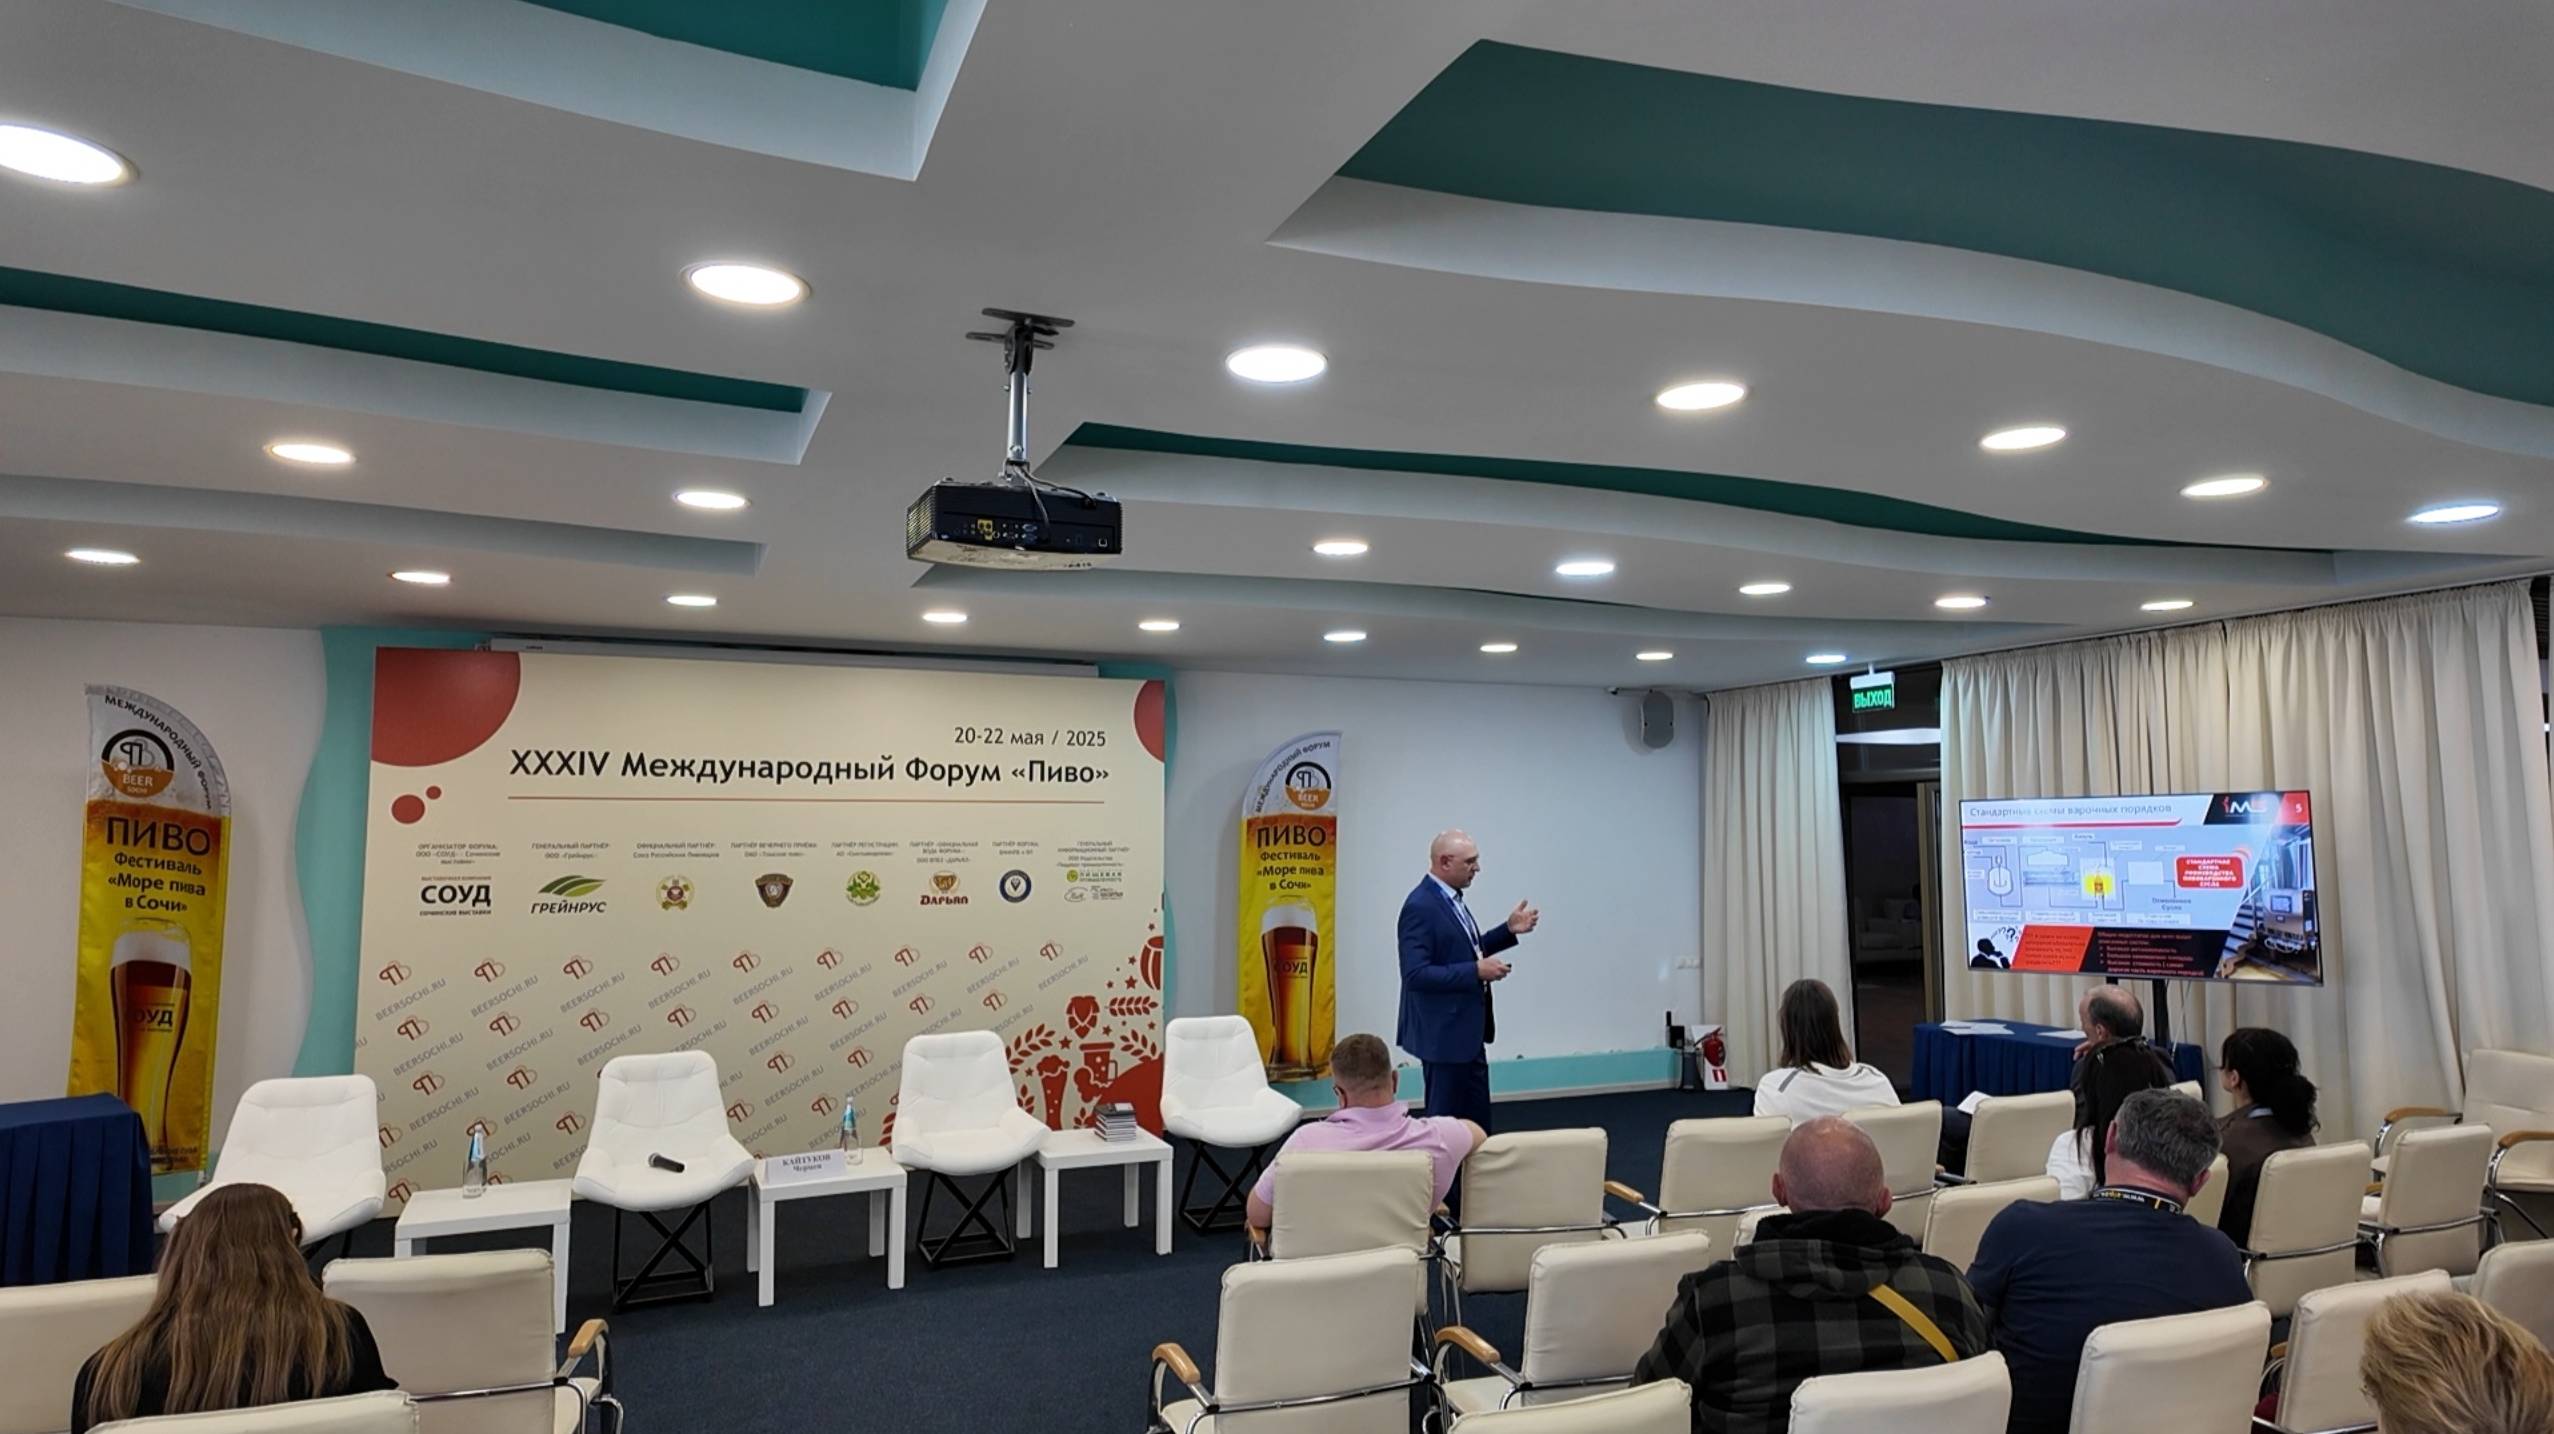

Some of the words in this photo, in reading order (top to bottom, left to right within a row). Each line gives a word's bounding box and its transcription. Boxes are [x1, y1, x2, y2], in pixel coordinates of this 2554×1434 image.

[1854, 689, 1892, 709] ВЫХОД
[105, 694, 202, 769] МЕЖДУНАРОДНЫЙ
[954, 727, 1004, 746] 20-22
[1010, 731, 1044, 746] мая
[1066, 730, 1106, 748] 2025
[1302, 741, 1331, 753] ФОРУМ
[122, 774, 153, 787] BEER
[509, 750, 611, 776] XXXIV
[621, 752, 895, 784] Международный
[905, 756, 1001, 787] Форум
[1011, 760, 1109, 783] «Пиво»
[2067, 805, 2117, 815] варочных
[106, 816, 211, 856] ПИВО
[1257, 825, 1326, 848] ПИВО
[114, 851, 202, 876] Фестиваль
[1257, 865, 1297, 878] «Море
[1299, 866, 1325, 877] пива
[1260, 851, 1321, 862] Фестиваль
[108, 874, 165, 893] «Море
[169, 880, 206, 896] пива
[420, 885, 491, 907] СОУД
[1269, 881, 1277, 890] в
[1279, 878, 1312, 890] Сочи»
[125, 896, 134, 909] в
[136, 894, 188, 913] Сочи»
[530, 900, 608, 914] ГРЕЙНРУС
[375, 978, 447, 1022] BEERSOCHI.RU
[471, 975, 539, 1018] BEERSOCHI.RU
[560, 971, 626, 1014] BEERSOCHI.RU
[648, 968, 711, 1010] BEERSOCHI.RU
[733, 966, 794, 1005] BEERSOCHI.RU
[486, 1028, 554, 1071] BEERSOCHI.RU
[577, 1024, 642, 1066] BEERSOCHI.RU
[749, 1016, 809, 1056] BEERSOCHI.RU
[829, 1012, 888, 1051] BEERSOCHI.RU
[393, 1032, 464, 1076] BEERSOCHI.RU
[504, 1082, 570, 1125] BEERSOCHI.RU
[764, 1065, 825, 1107] BEERSOCHI.RU
[409, 1087, 480, 1131] BEERSOCHI.RU
